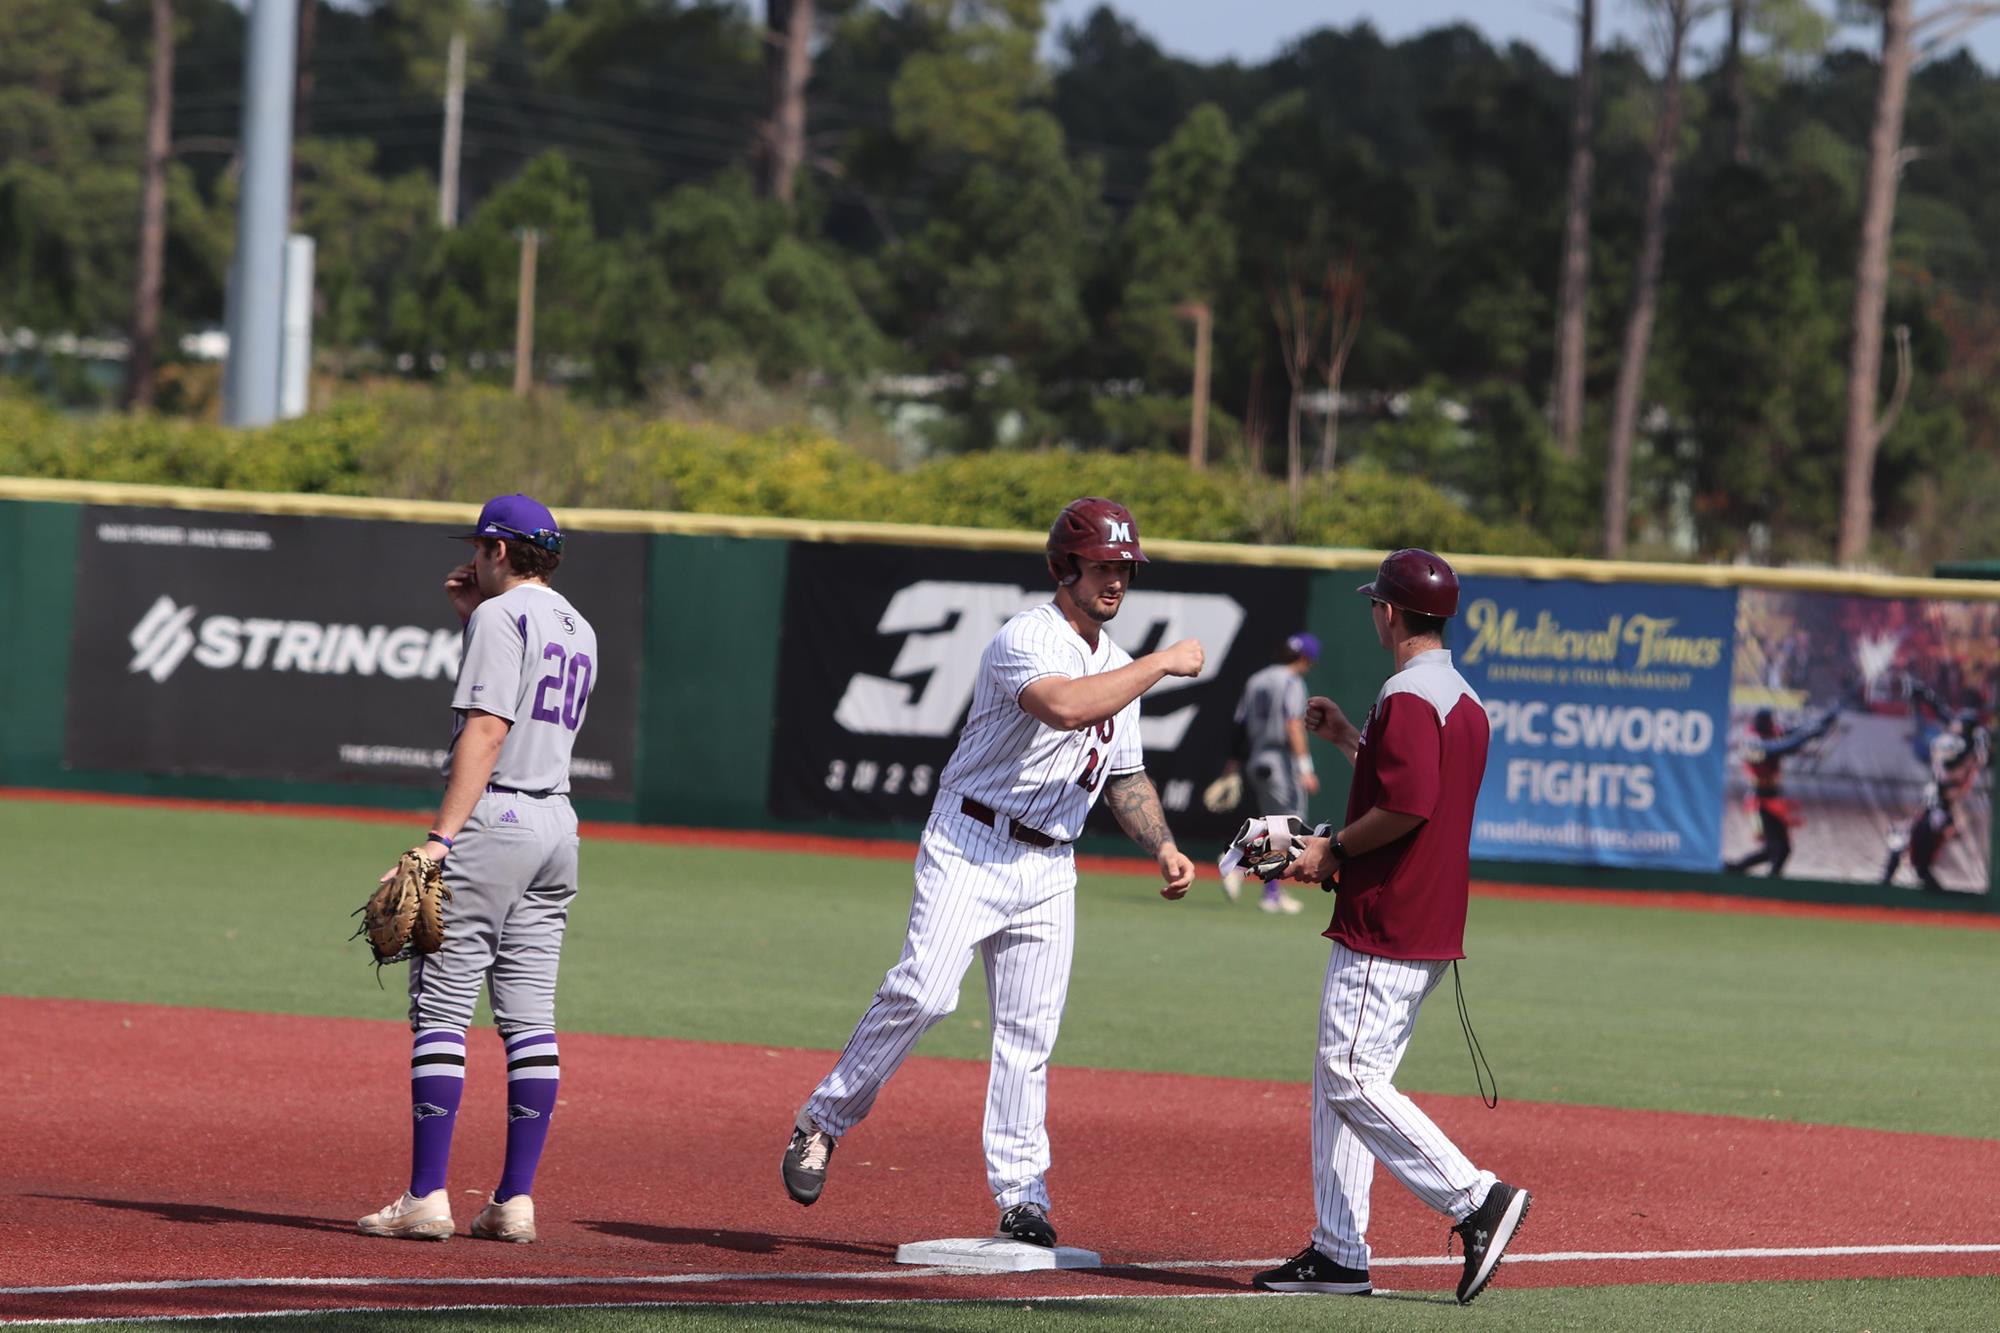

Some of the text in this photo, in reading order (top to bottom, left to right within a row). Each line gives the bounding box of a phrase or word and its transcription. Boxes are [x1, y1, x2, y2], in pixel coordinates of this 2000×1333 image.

[1106, 519, 1133, 543] M
[195, 614, 464, 681] STRINGK
[1461, 598, 1724, 670] Medieval Times
[531, 641, 592, 732] 20
[1484, 699, 1714, 756] PIC SWORD
[1506, 757, 1656, 812] FIGHTS
